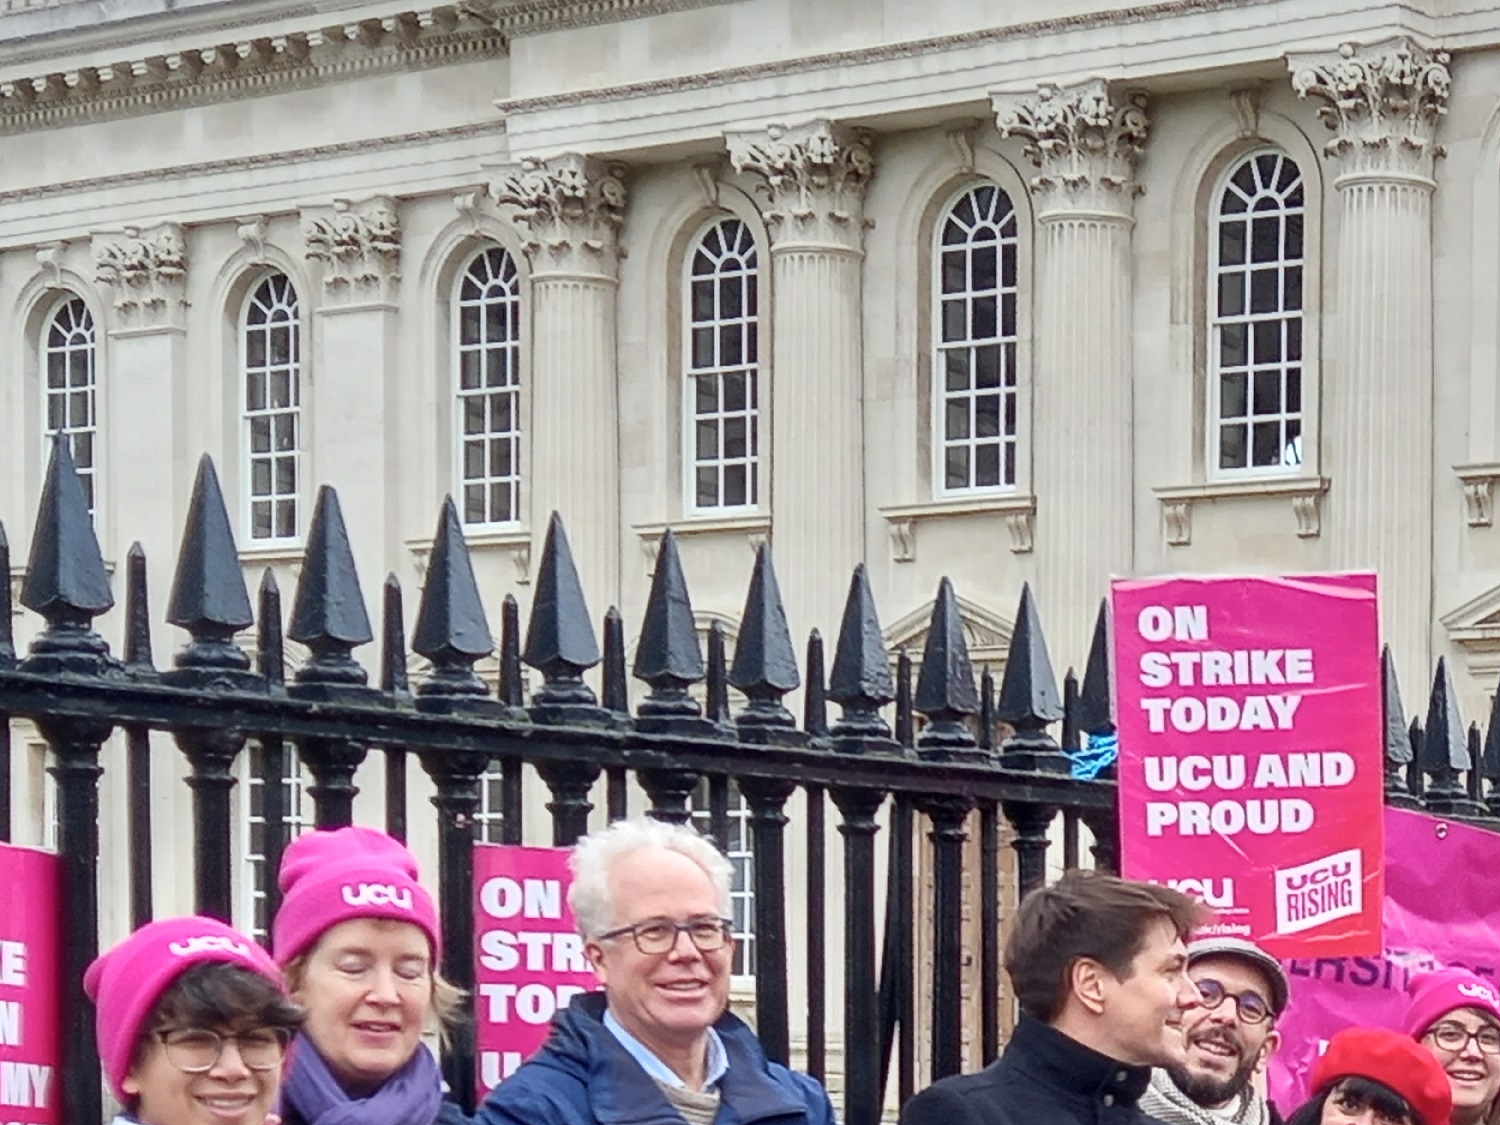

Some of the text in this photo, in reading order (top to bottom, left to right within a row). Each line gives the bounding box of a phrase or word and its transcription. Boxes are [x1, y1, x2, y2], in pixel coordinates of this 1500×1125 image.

[1138, 605, 1208, 641] ON
[1140, 648, 1315, 687] STRIKE
[1141, 695, 1303, 732] TODAY
[1144, 751, 1356, 791] UCU AND
[1146, 798, 1315, 836] PROUD
[1150, 877, 1234, 907] CU
[1286, 862, 1351, 890] UCU
[342, 884, 414, 909] UCU
[480, 877, 561, 919] ON
[1287, 879, 1353, 921] RISING
